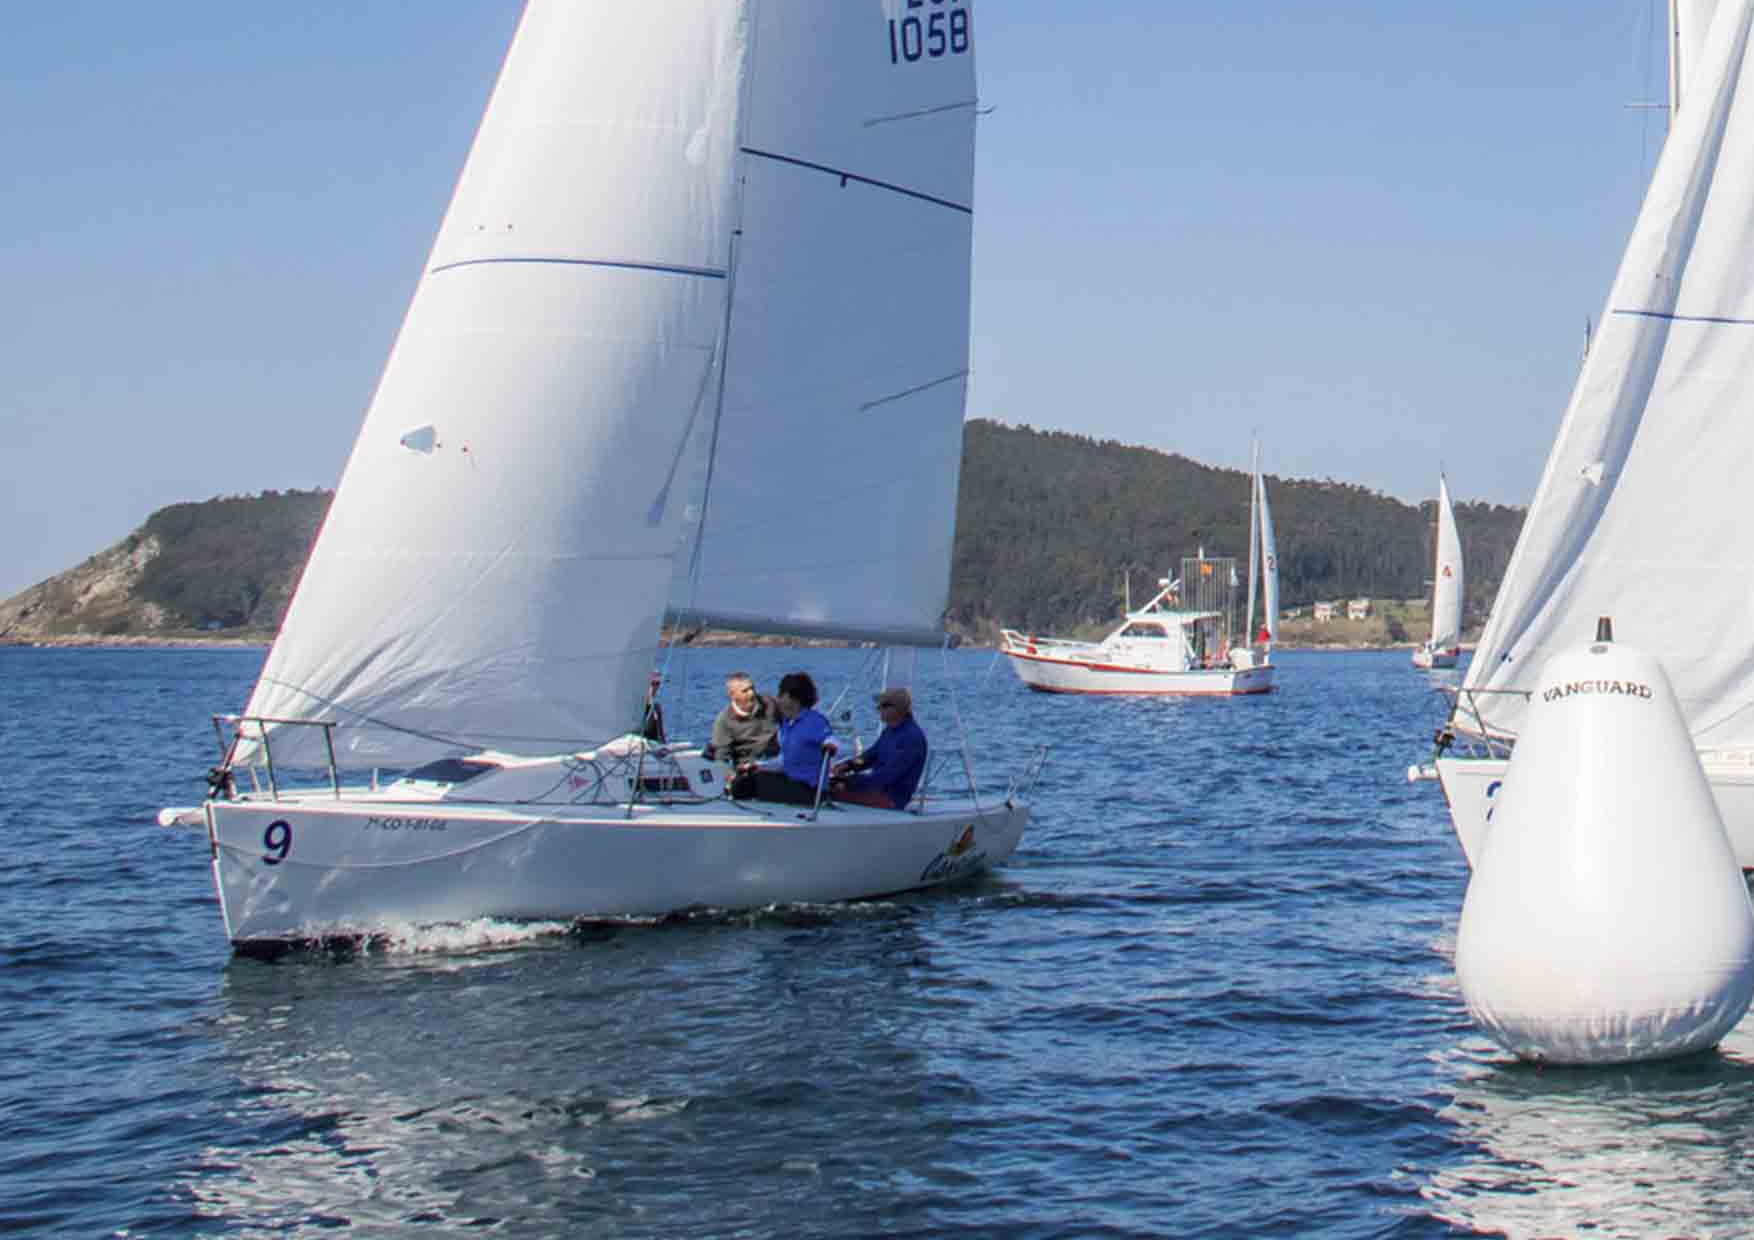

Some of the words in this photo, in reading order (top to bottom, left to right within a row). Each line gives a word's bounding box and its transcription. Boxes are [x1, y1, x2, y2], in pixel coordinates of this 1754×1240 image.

[889, 8, 969, 64] 1058
[1543, 679, 1653, 703] VANGUARD
[262, 819, 293, 866] 9
